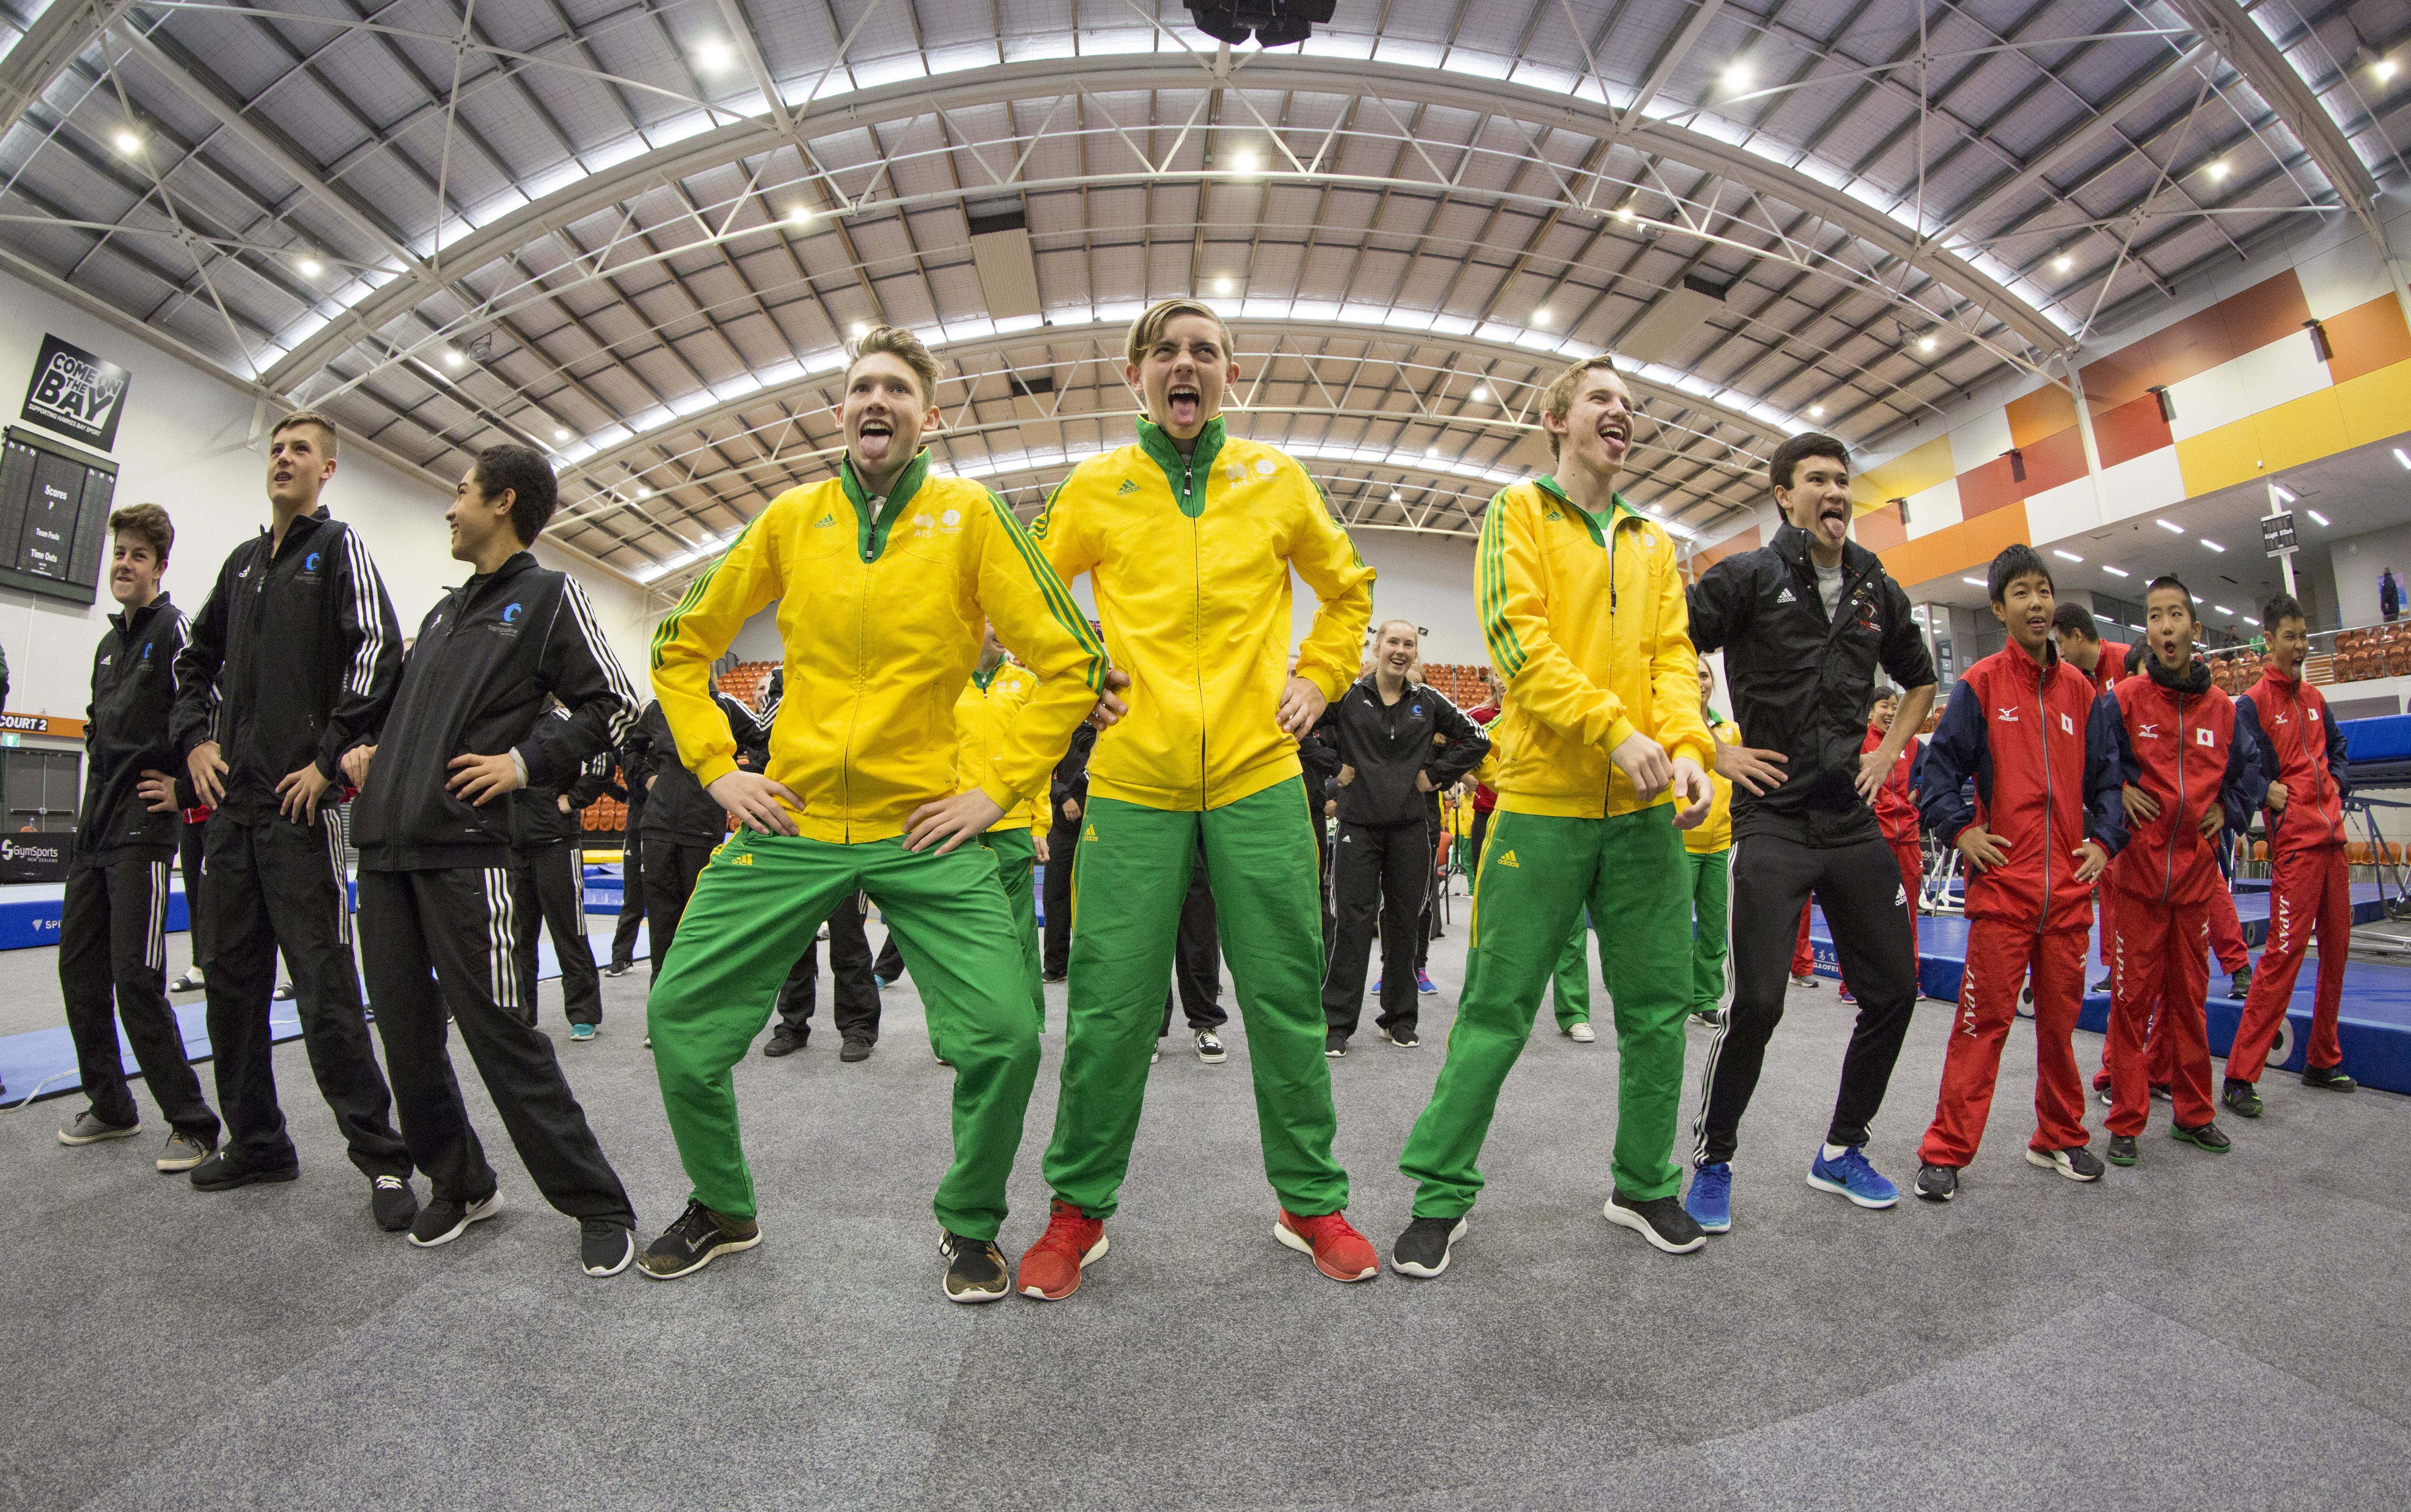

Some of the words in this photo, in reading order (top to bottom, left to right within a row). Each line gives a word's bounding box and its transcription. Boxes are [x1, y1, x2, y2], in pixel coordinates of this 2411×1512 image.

[53, 354, 98, 384] COME
[98, 375, 122, 395] ON
[66, 377, 88, 394] THE
[35, 368, 114, 422] BAY
[28, 403, 57, 419] SUPPORTING
[57, 415, 76, 427] HAWKES
[76, 422, 87, 431] BAY
[86, 426, 101, 437] SPORT
[1117, 486, 1141, 496] adidas
[1231, 479, 1249, 490] AIS
[45, 485, 67, 500] Scores
[48, 501, 54, 510] P
[36, 527, 48, 538] Team
[48, 531, 60, 541] Fouls
[913, 529, 932, 538] AIS
[30, 548, 44, 559] Time
[45, 552, 57, 563] Outs
[488, 625, 518, 634] Trampoline
[0, 715, 37, 730] COURT
[38, 719, 47, 730] 2
[13, 845, 58, 859] GymSports
[1498, 859, 1519, 868] adidas
[45, 920, 61, 929] SPI
[2278, 895, 2290, 954] JAPAN
[1814, 962, 1839, 972] GAOFEI
[2115, 930, 2124, 1001] JAPAN
[1962, 964, 1977, 1039] JAPAN
